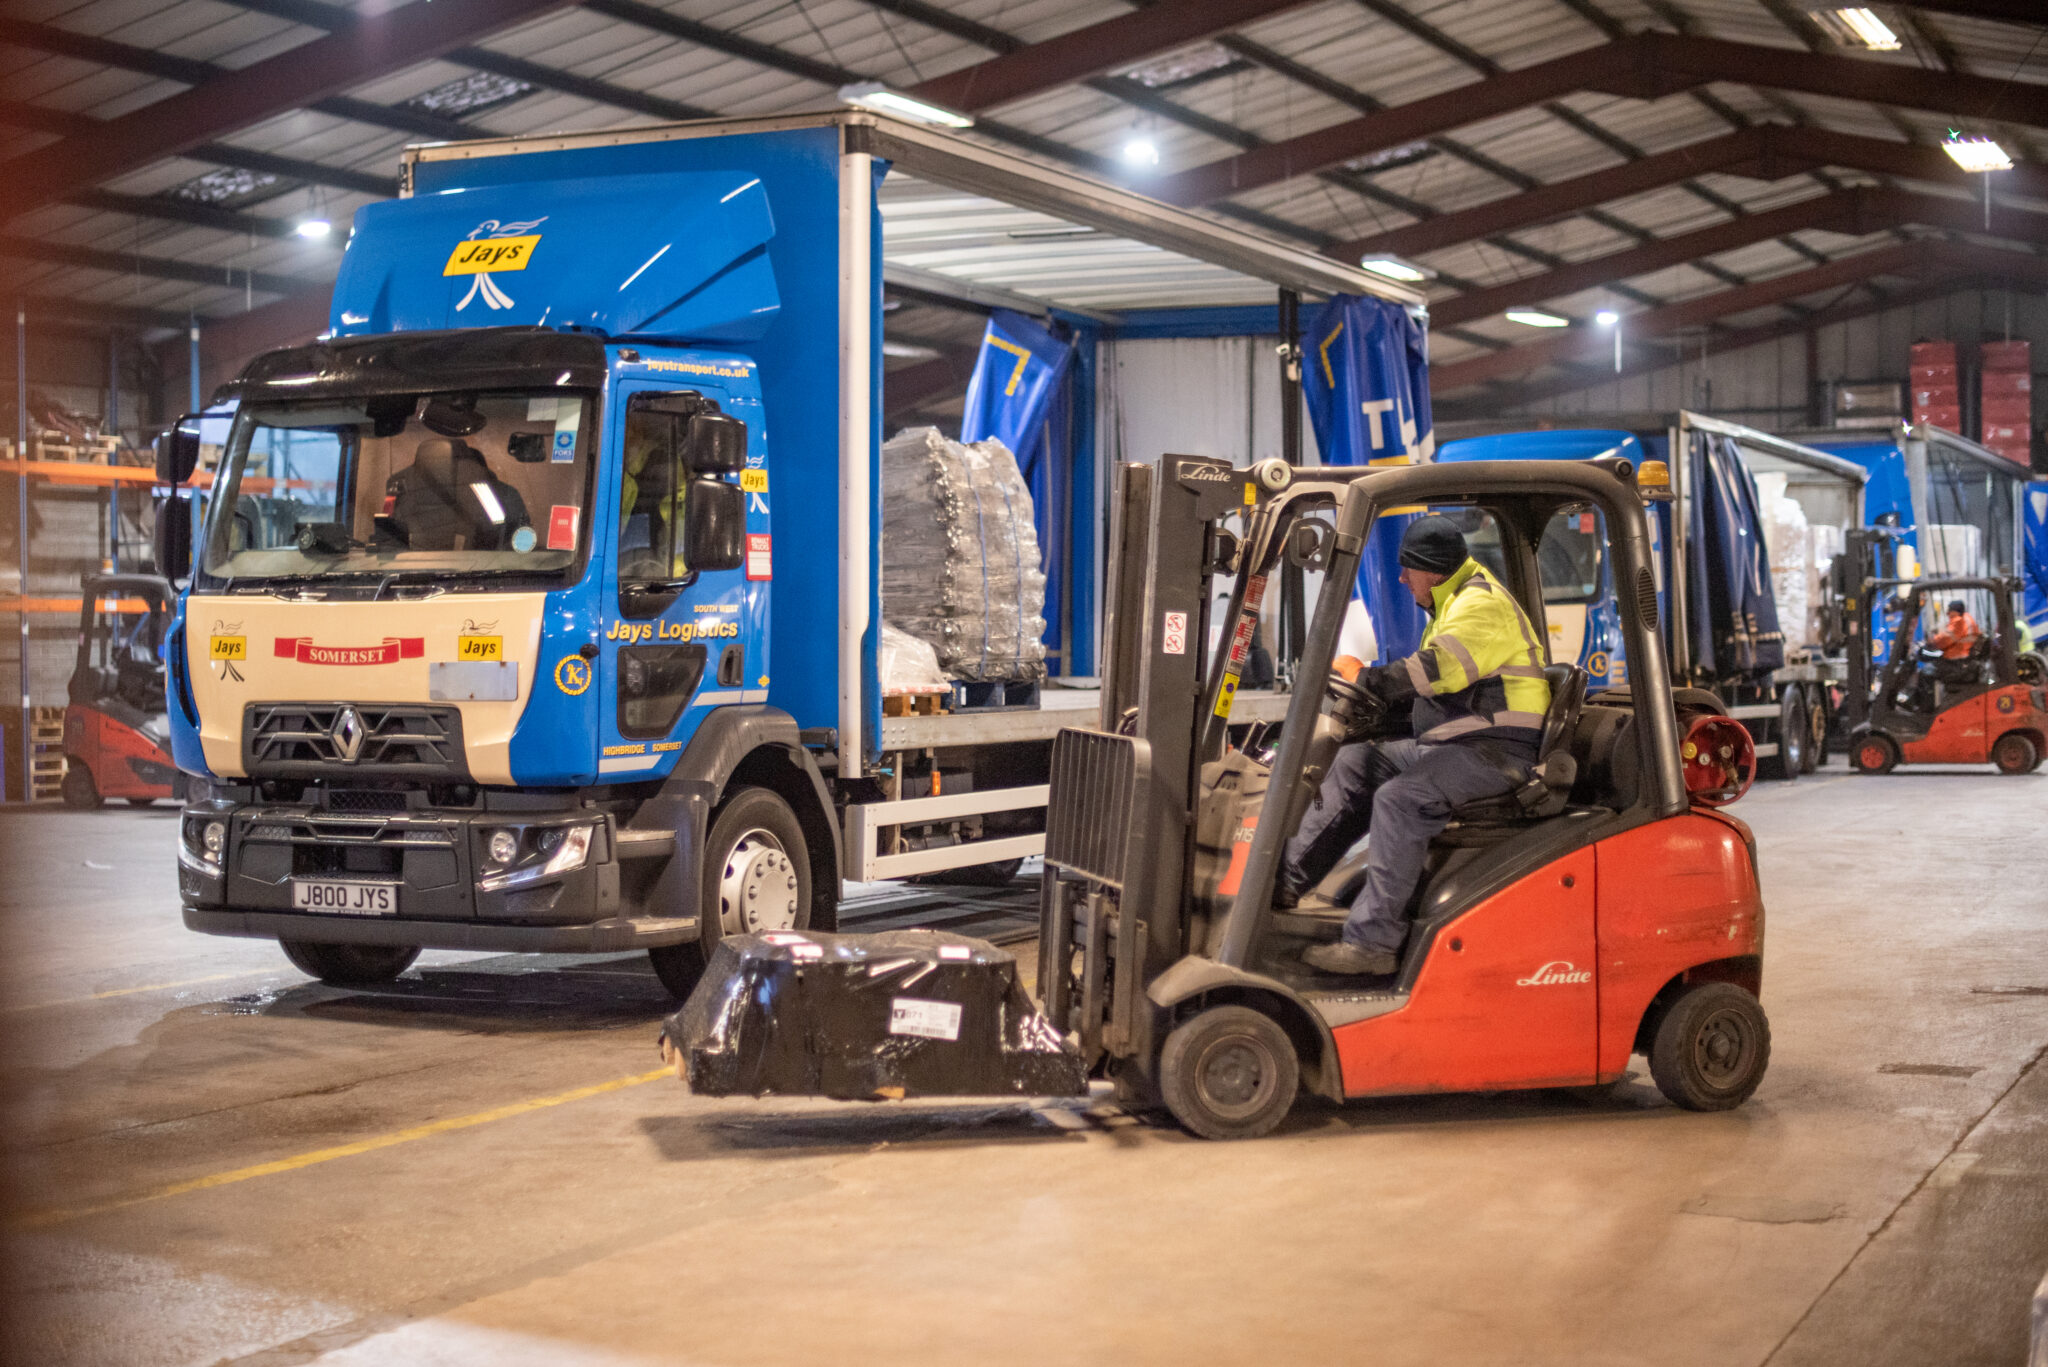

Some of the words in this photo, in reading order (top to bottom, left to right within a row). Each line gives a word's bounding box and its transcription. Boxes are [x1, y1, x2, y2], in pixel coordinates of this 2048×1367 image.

[460, 245, 524, 265] Jays
[647, 359, 750, 378] jaystransport.co.uk
[744, 474, 765, 488] Jays
[1181, 465, 1231, 482] Linde
[694, 604, 717, 613] SOUTH
[606, 620, 652, 643] Jays
[215, 639, 242, 655] Jays
[464, 640, 497, 656] Jays
[309, 648, 386, 664] SOMERSET
[603, 743, 646, 756] HIGHBRIDGE
[652, 741, 683, 752] SOMERSET
[301, 885, 347, 907] J800
[354, 888, 389, 909] JYS
[1516, 961, 1592, 986] Linde
